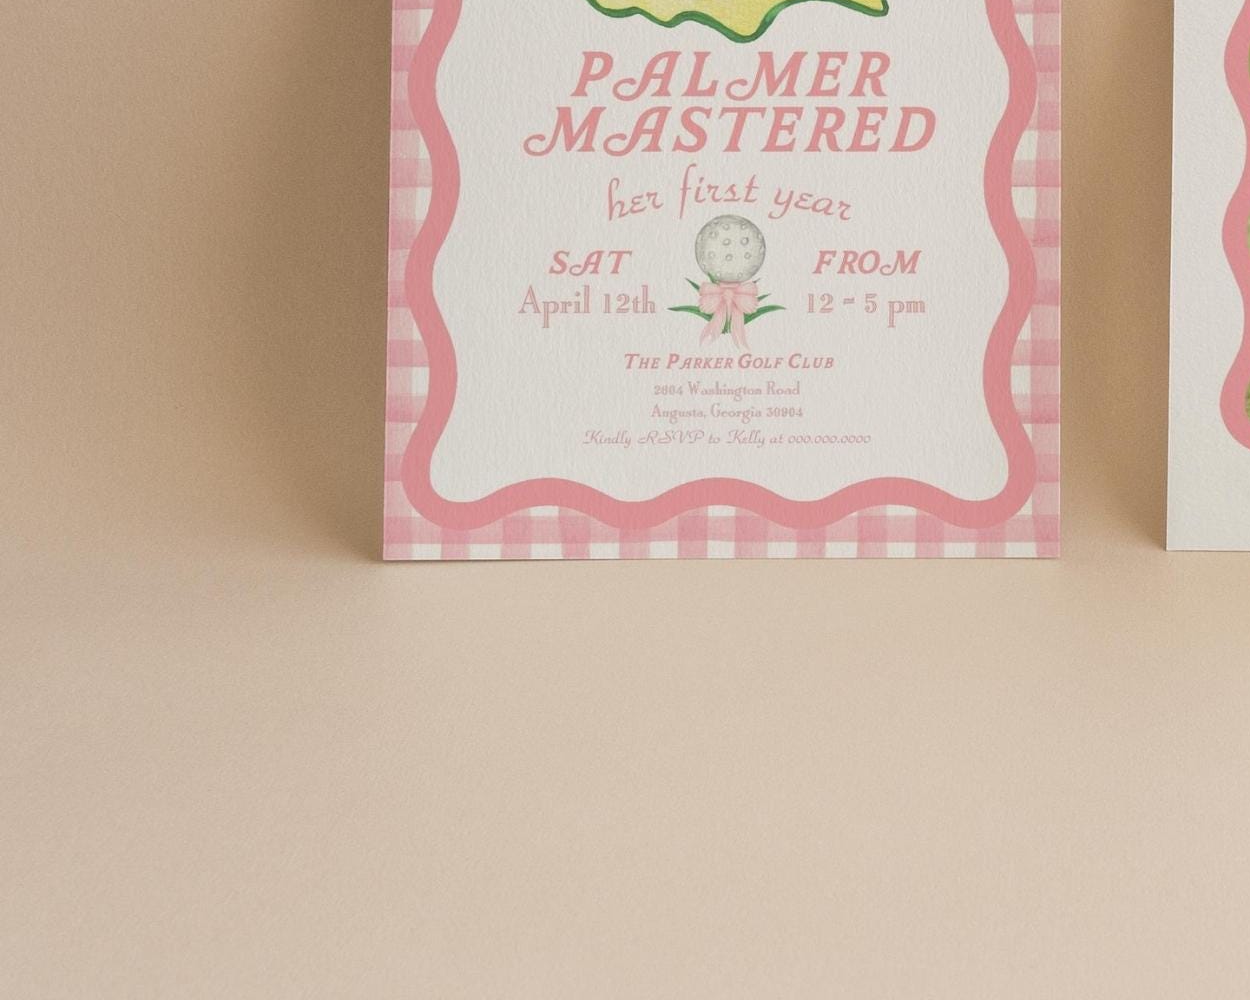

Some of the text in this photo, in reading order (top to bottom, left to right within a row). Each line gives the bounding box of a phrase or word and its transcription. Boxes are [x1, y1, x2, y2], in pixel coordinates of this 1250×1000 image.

[570, 51, 892, 102] PALMER
[523, 106, 938, 157] MASTERED
[608, 163, 853, 222] her first year
[548, 250, 632, 276] SAT
[812, 250, 922, 275] FROM
[518, 284, 656, 329] April 12th
[807, 293, 835, 314] 12
[864, 293, 879, 314] 5
[888, 297, 927, 329] pm
[688, 381, 763, 402] Washington
[766, 381, 801, 396] Road
[710, 403, 763, 424] Georgia
[583, 430, 632, 449] Kindly
[637, 429, 705, 445] RSVP
[707, 433, 721, 445] to
[725, 429, 765, 449] Kelly
[769, 433, 784, 444] at
